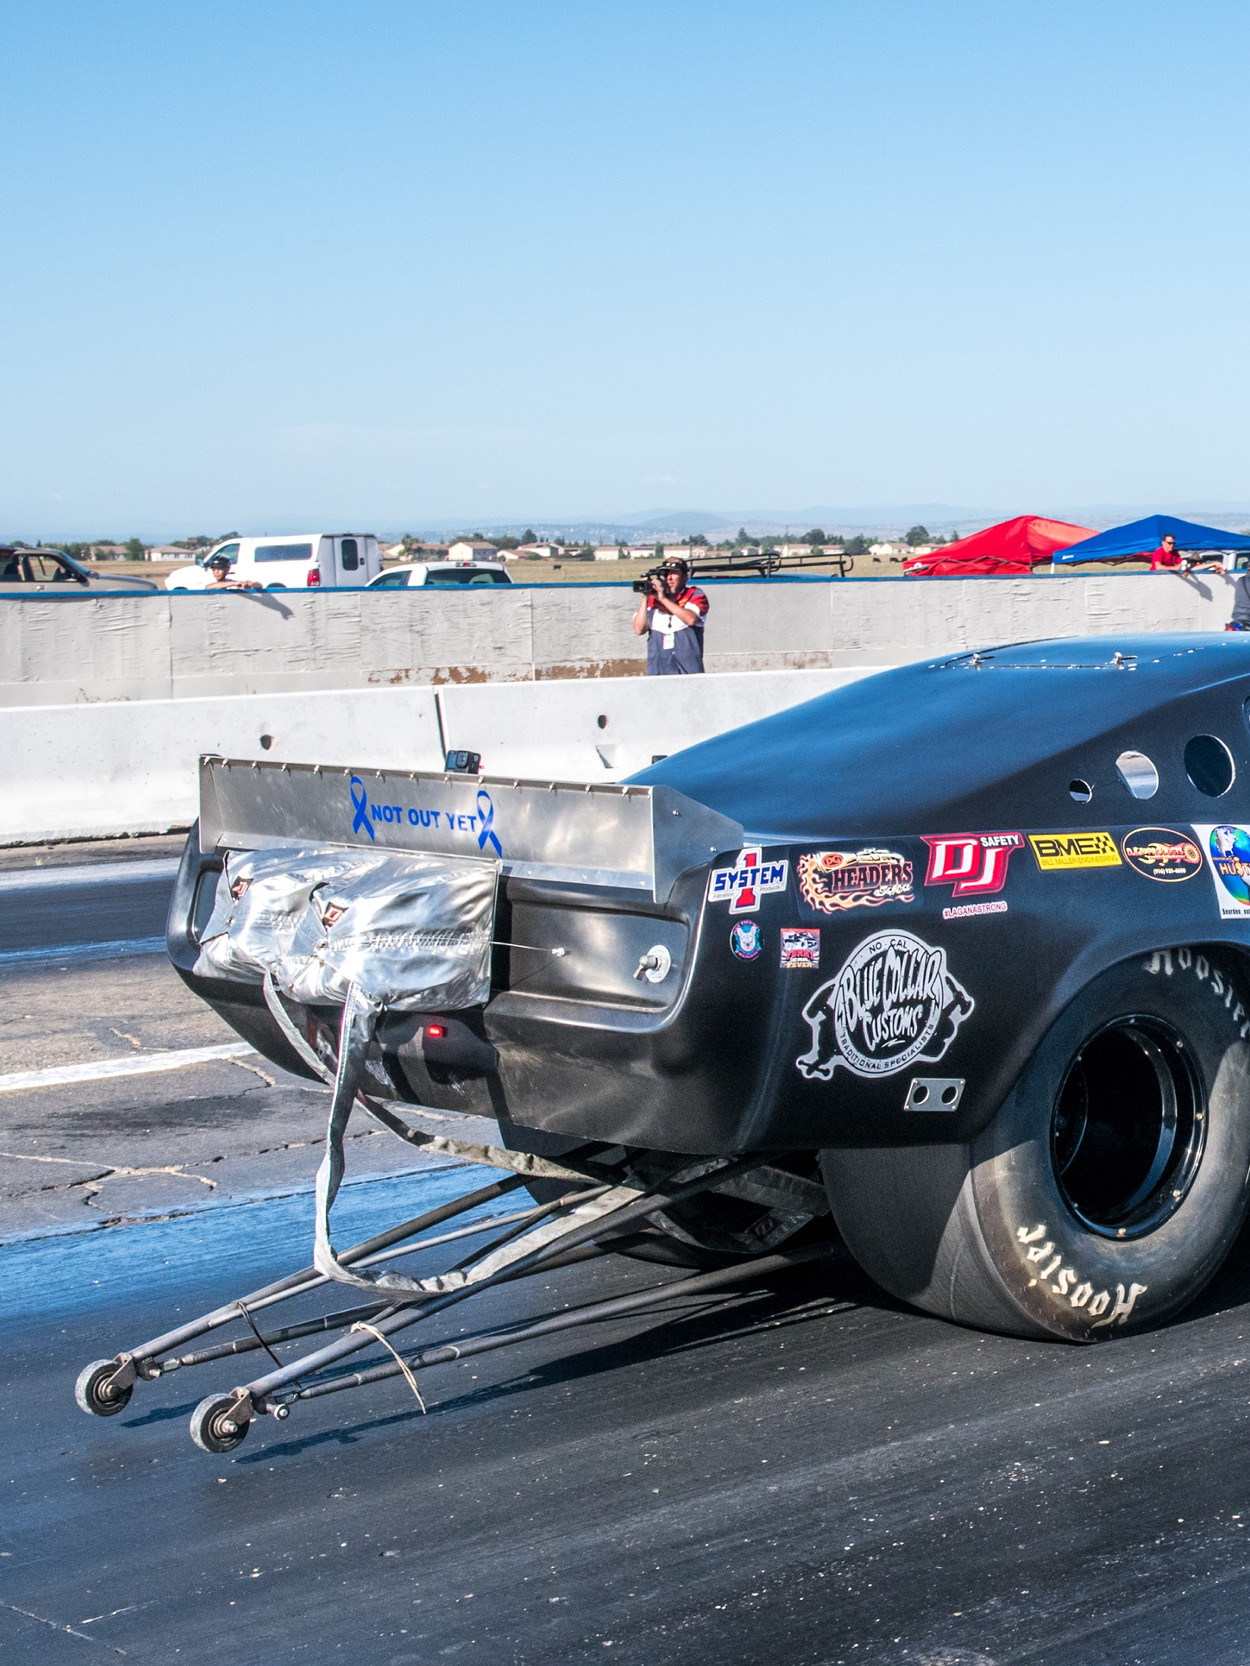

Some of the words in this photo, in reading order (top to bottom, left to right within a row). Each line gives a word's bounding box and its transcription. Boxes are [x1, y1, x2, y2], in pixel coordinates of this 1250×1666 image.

[371, 804, 403, 824] NOT
[407, 808, 441, 829] OUT
[445, 812, 477, 833] YET
[980, 835, 1019, 848] SAFETY
[1034, 838, 1100, 858] BME
[930, 839, 1008, 892] DJ
[1041, 858, 1055, 866] BILL
[1055, 857, 1077, 866] MILLER
[714, 865, 784, 892] SYSTEM
[832, 862, 913, 892] HEADERS
[943, 902, 1007, 918] #LAGANASTRONG
[840, 956, 884, 1032] BLUE
[862, 1004, 924, 1052] CUSTOMS
[839, 1032, 882, 1070] TRADITIONAL
[884, 1022, 935, 1069] SPECIALISTS
